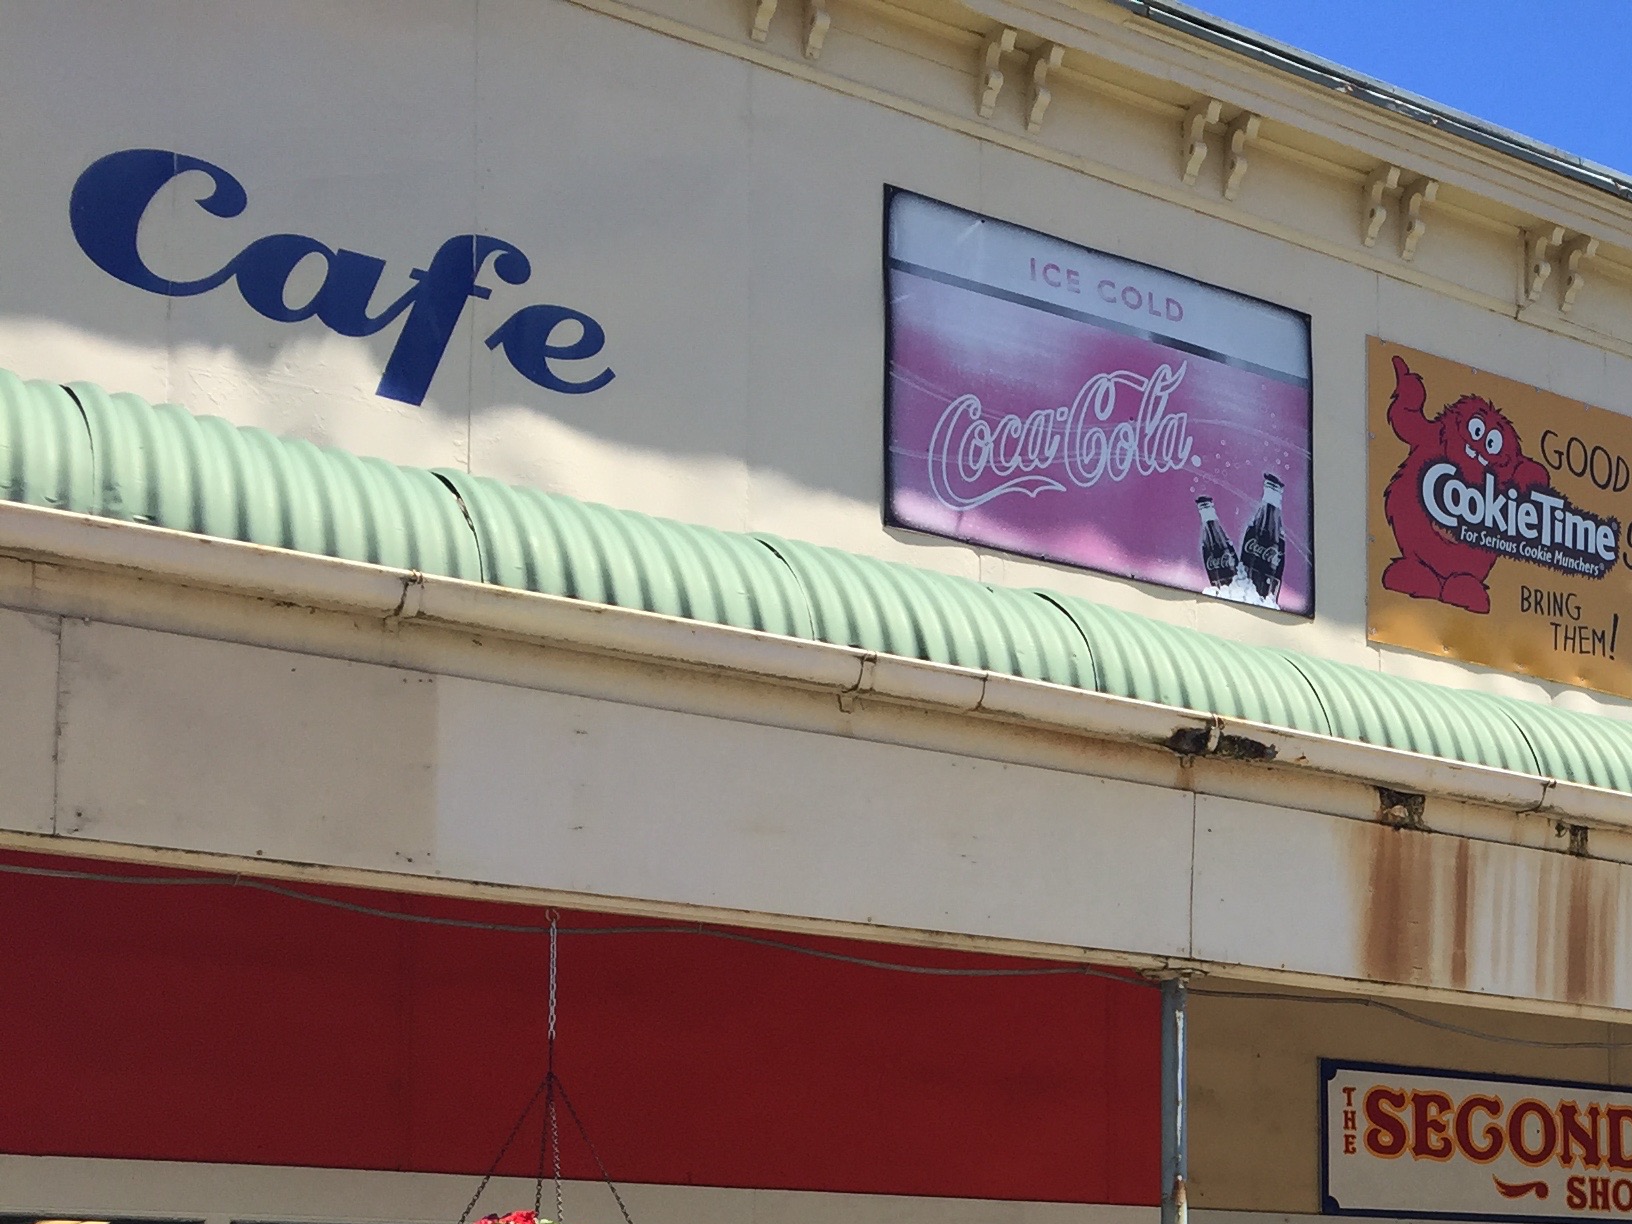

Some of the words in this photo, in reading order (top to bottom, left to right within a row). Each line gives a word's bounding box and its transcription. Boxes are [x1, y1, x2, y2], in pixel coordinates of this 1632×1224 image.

[69, 148, 616, 406] Cafe
[1030, 257, 1080, 294] ICE
[1098, 280, 1184, 322] COLD
[1541, 429, 1629, 492] GOOD
[1422, 463, 1616, 559] CookieTime
[1461, 526, 1477, 543] For
[1480, 531, 1517, 553] Serious
[1519, 541, 1552, 562] Cookie
[1554, 551, 1599, 576] Munchers
[1521, 586, 1581, 619] BRING
[1550, 613, 1619, 660] THEM!
[1342, 1087, 1357, 1155] THE
